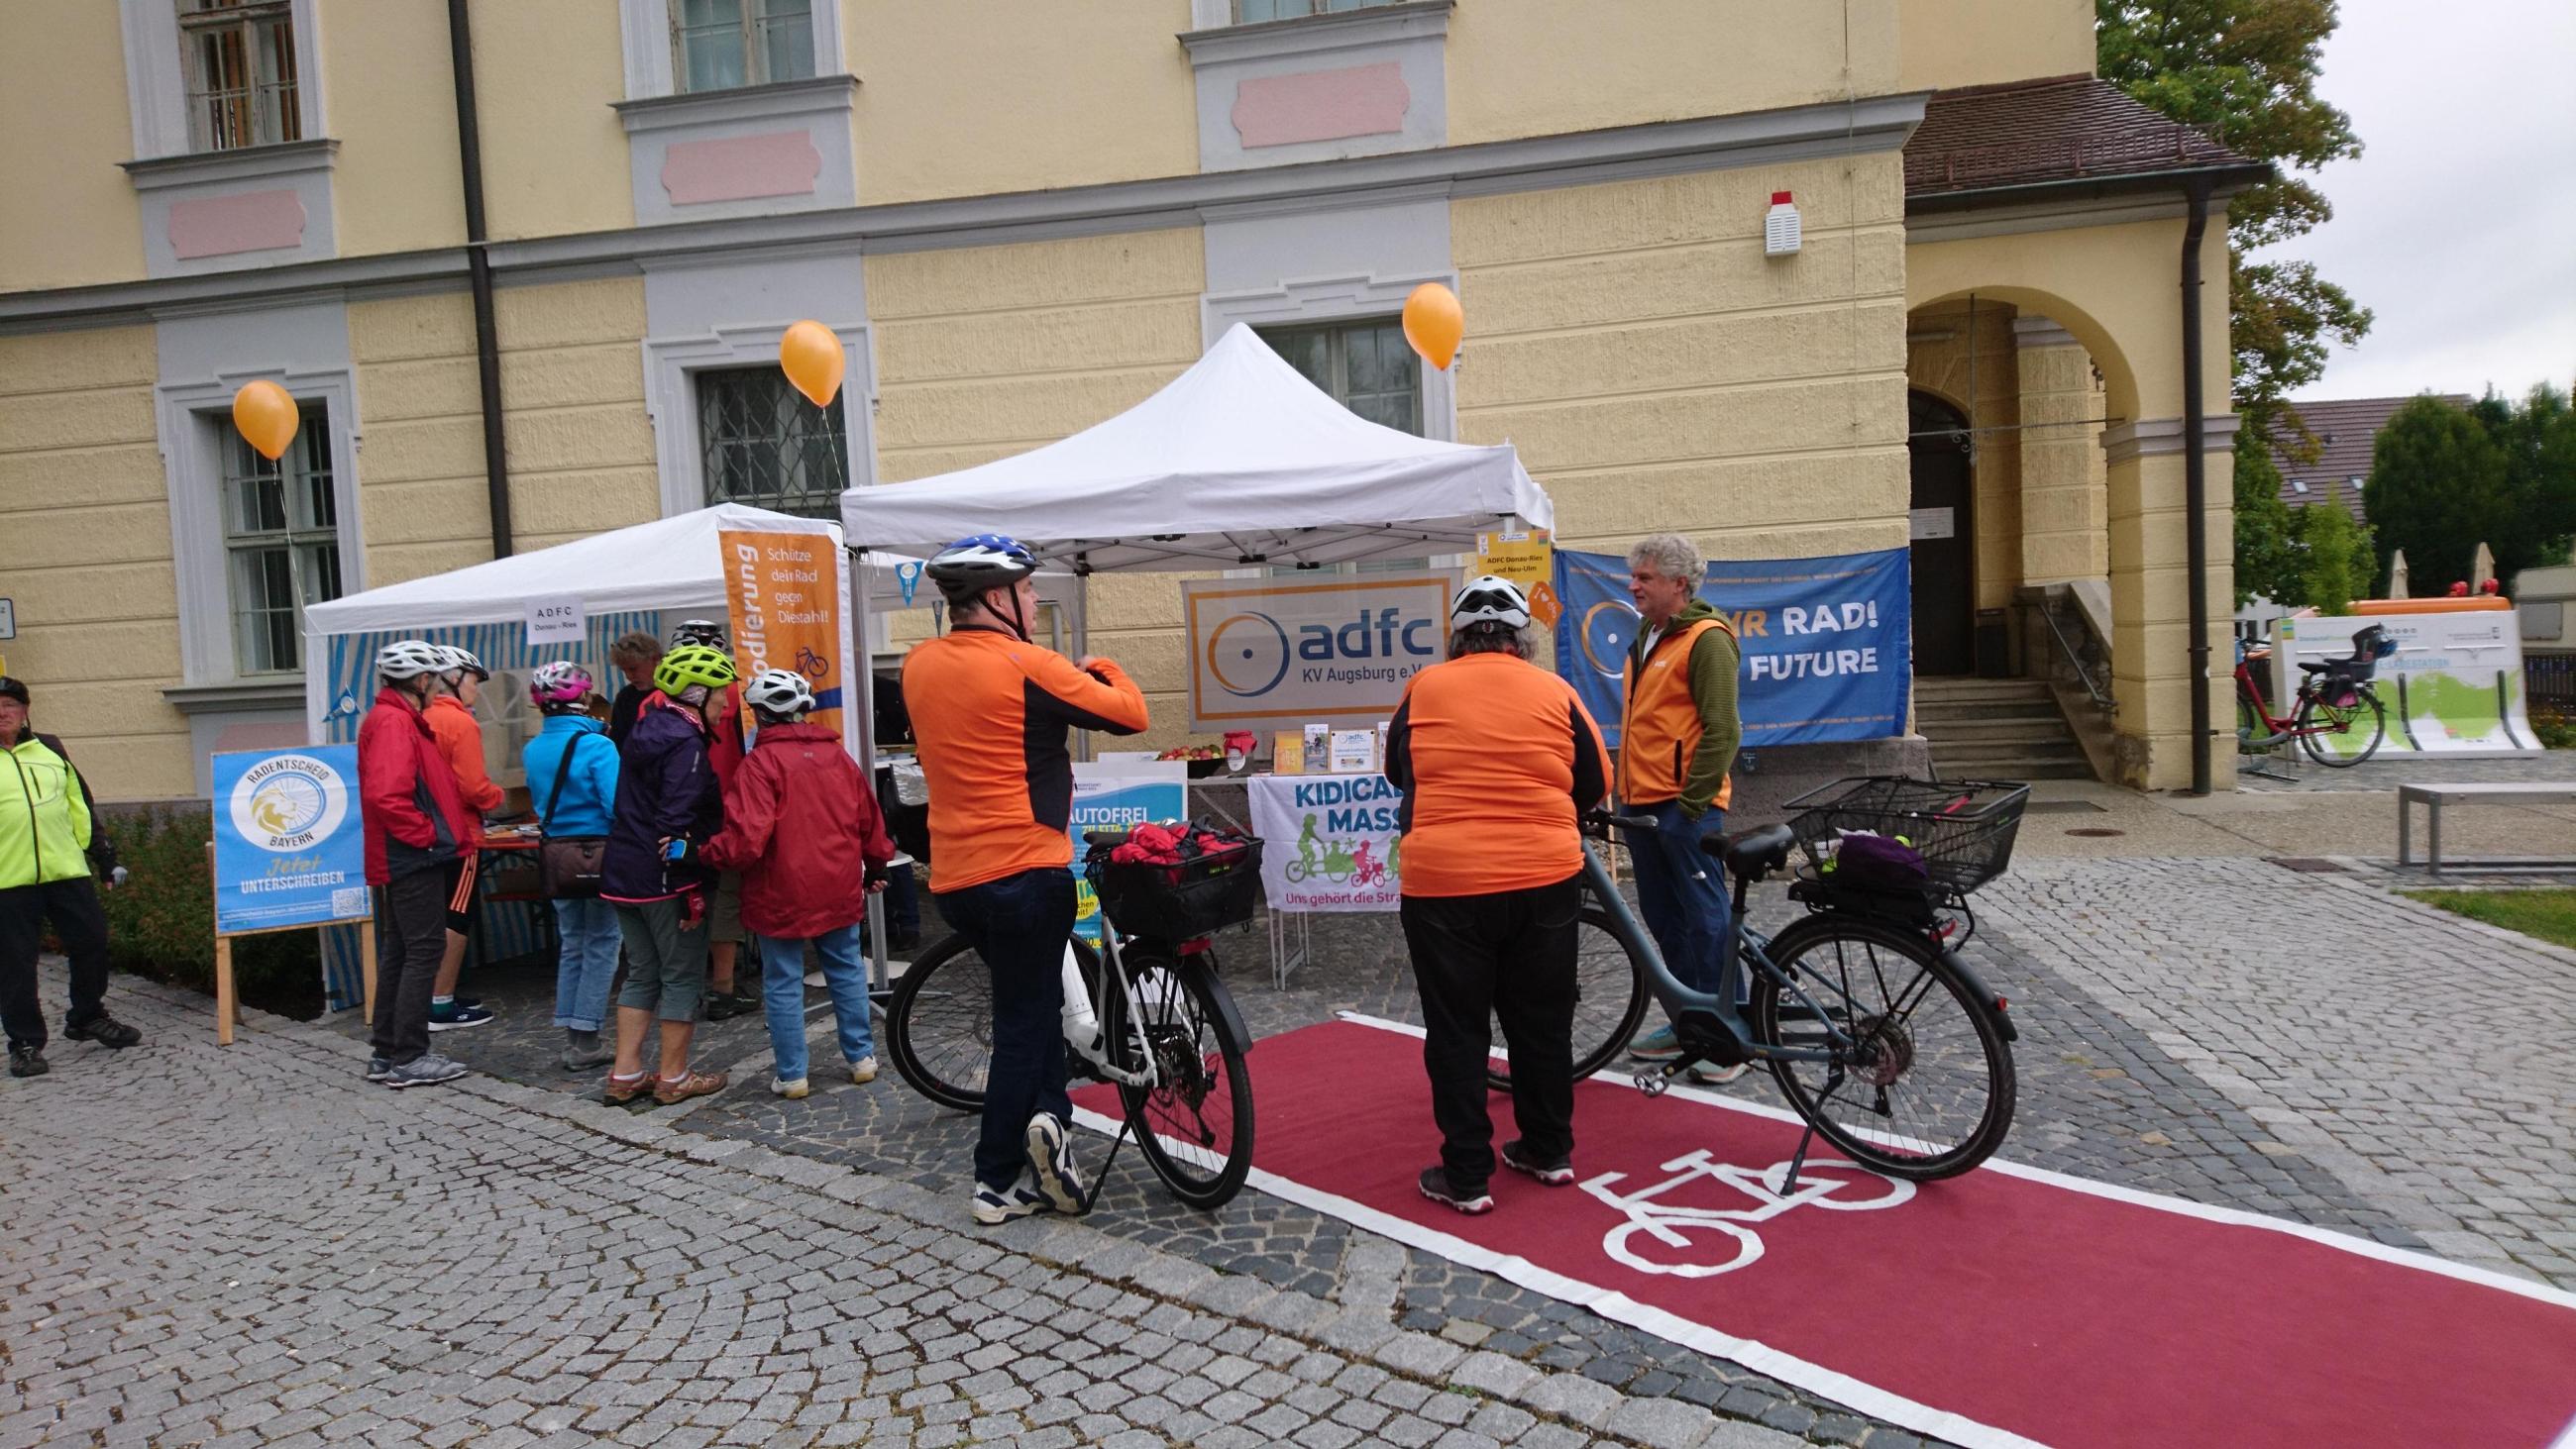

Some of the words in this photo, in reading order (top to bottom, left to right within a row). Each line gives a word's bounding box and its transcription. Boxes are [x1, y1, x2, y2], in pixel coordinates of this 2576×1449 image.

[767, 548, 811, 563] Schütze
[1506, 555, 1543, 564] Donau-Ries
[796, 569, 817, 582] Rad
[736, 544, 770, 685] odierung
[1784, 600, 1878, 636] RAD!
[1299, 608, 1434, 661] adfc
[1750, 647, 1878, 681] FUTURE
[1303, 668, 1323, 682] KV
[1327, 666, 1395, 684] Augsburg
[248, 759, 330, 783] RADENTSCHEID
[269, 831, 315, 847] BAYERN
[241, 871, 345, 894] UNTERSCHREIBEN
[1286, 892, 1308, 903] Uns
[1310, 891, 1351, 906] gehört
[1354, 892, 1374, 903] die
